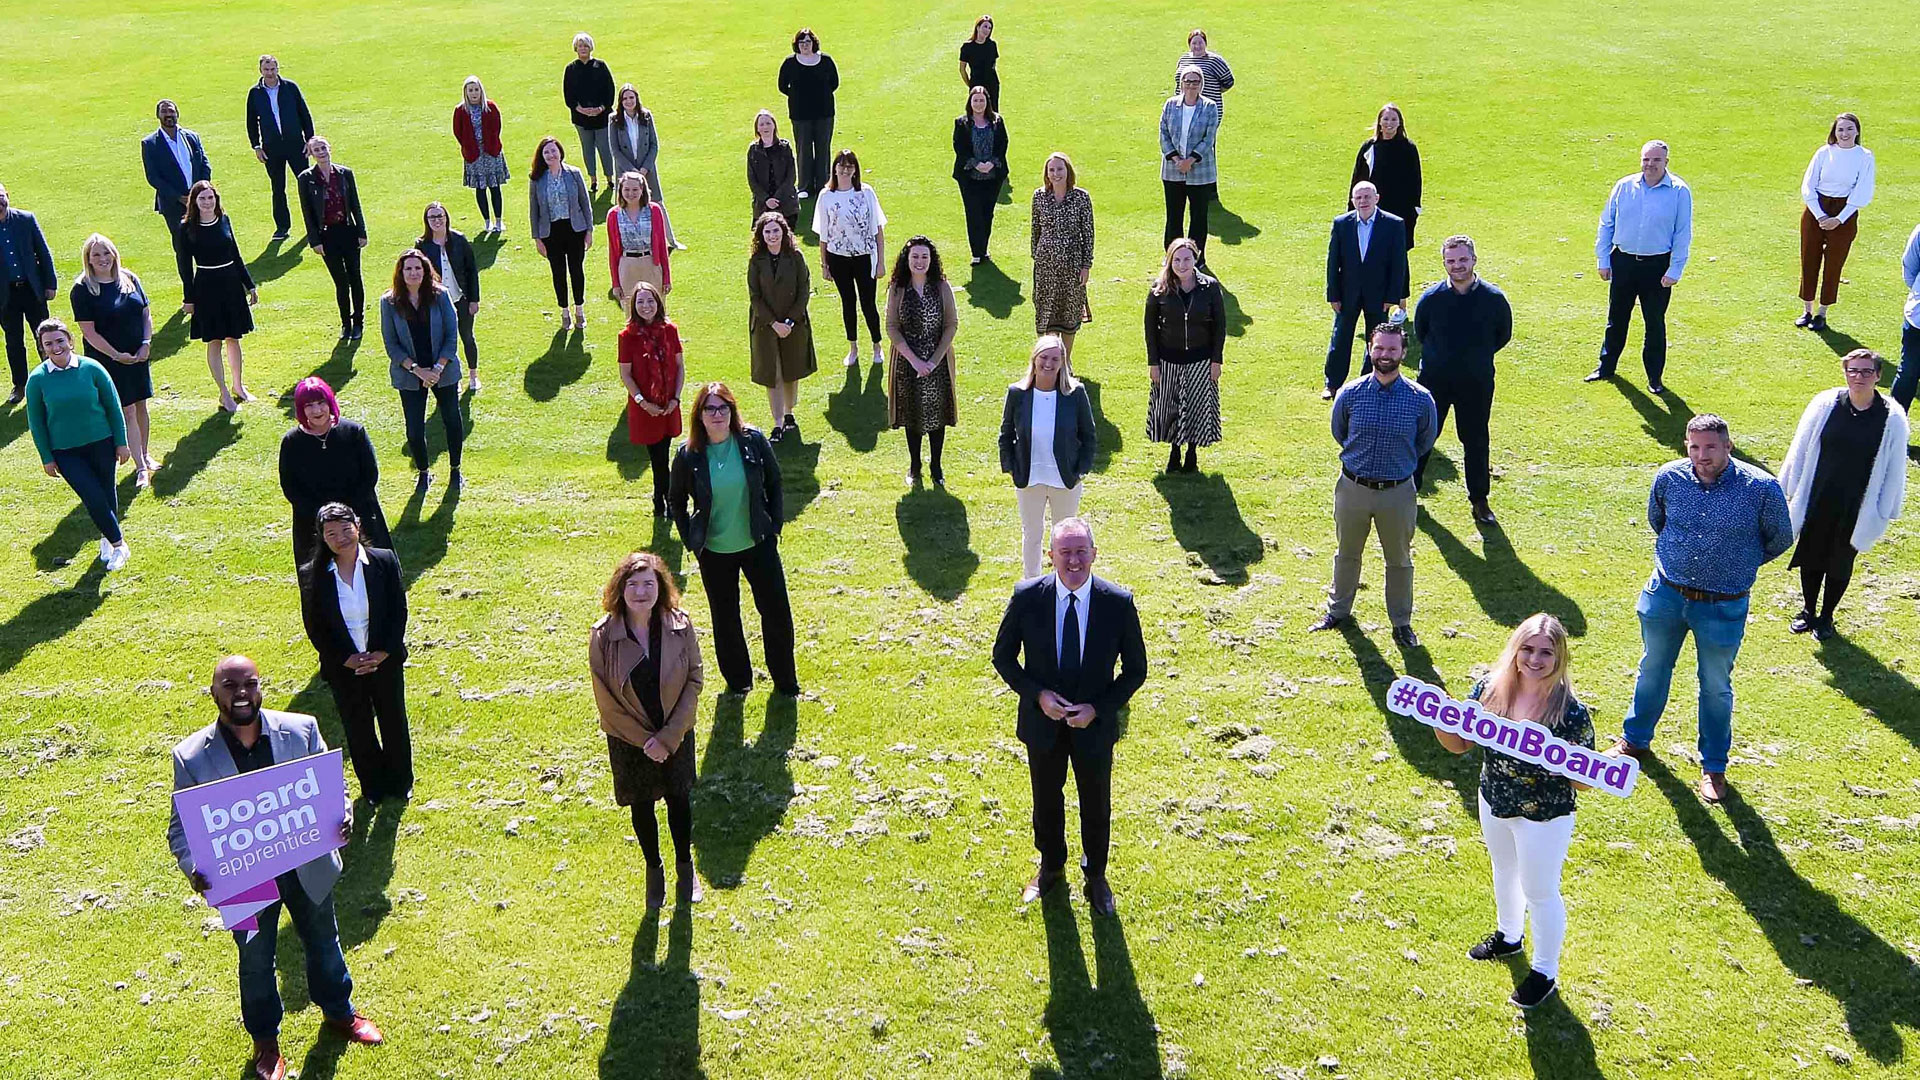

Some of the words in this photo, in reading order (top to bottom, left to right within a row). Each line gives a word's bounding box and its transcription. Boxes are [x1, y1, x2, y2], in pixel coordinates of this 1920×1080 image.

[1393, 682, 1631, 790] #GetonBoard
[200, 767, 320, 834] board
[211, 804, 317, 859] room
[218, 827, 321, 876] apprentice
